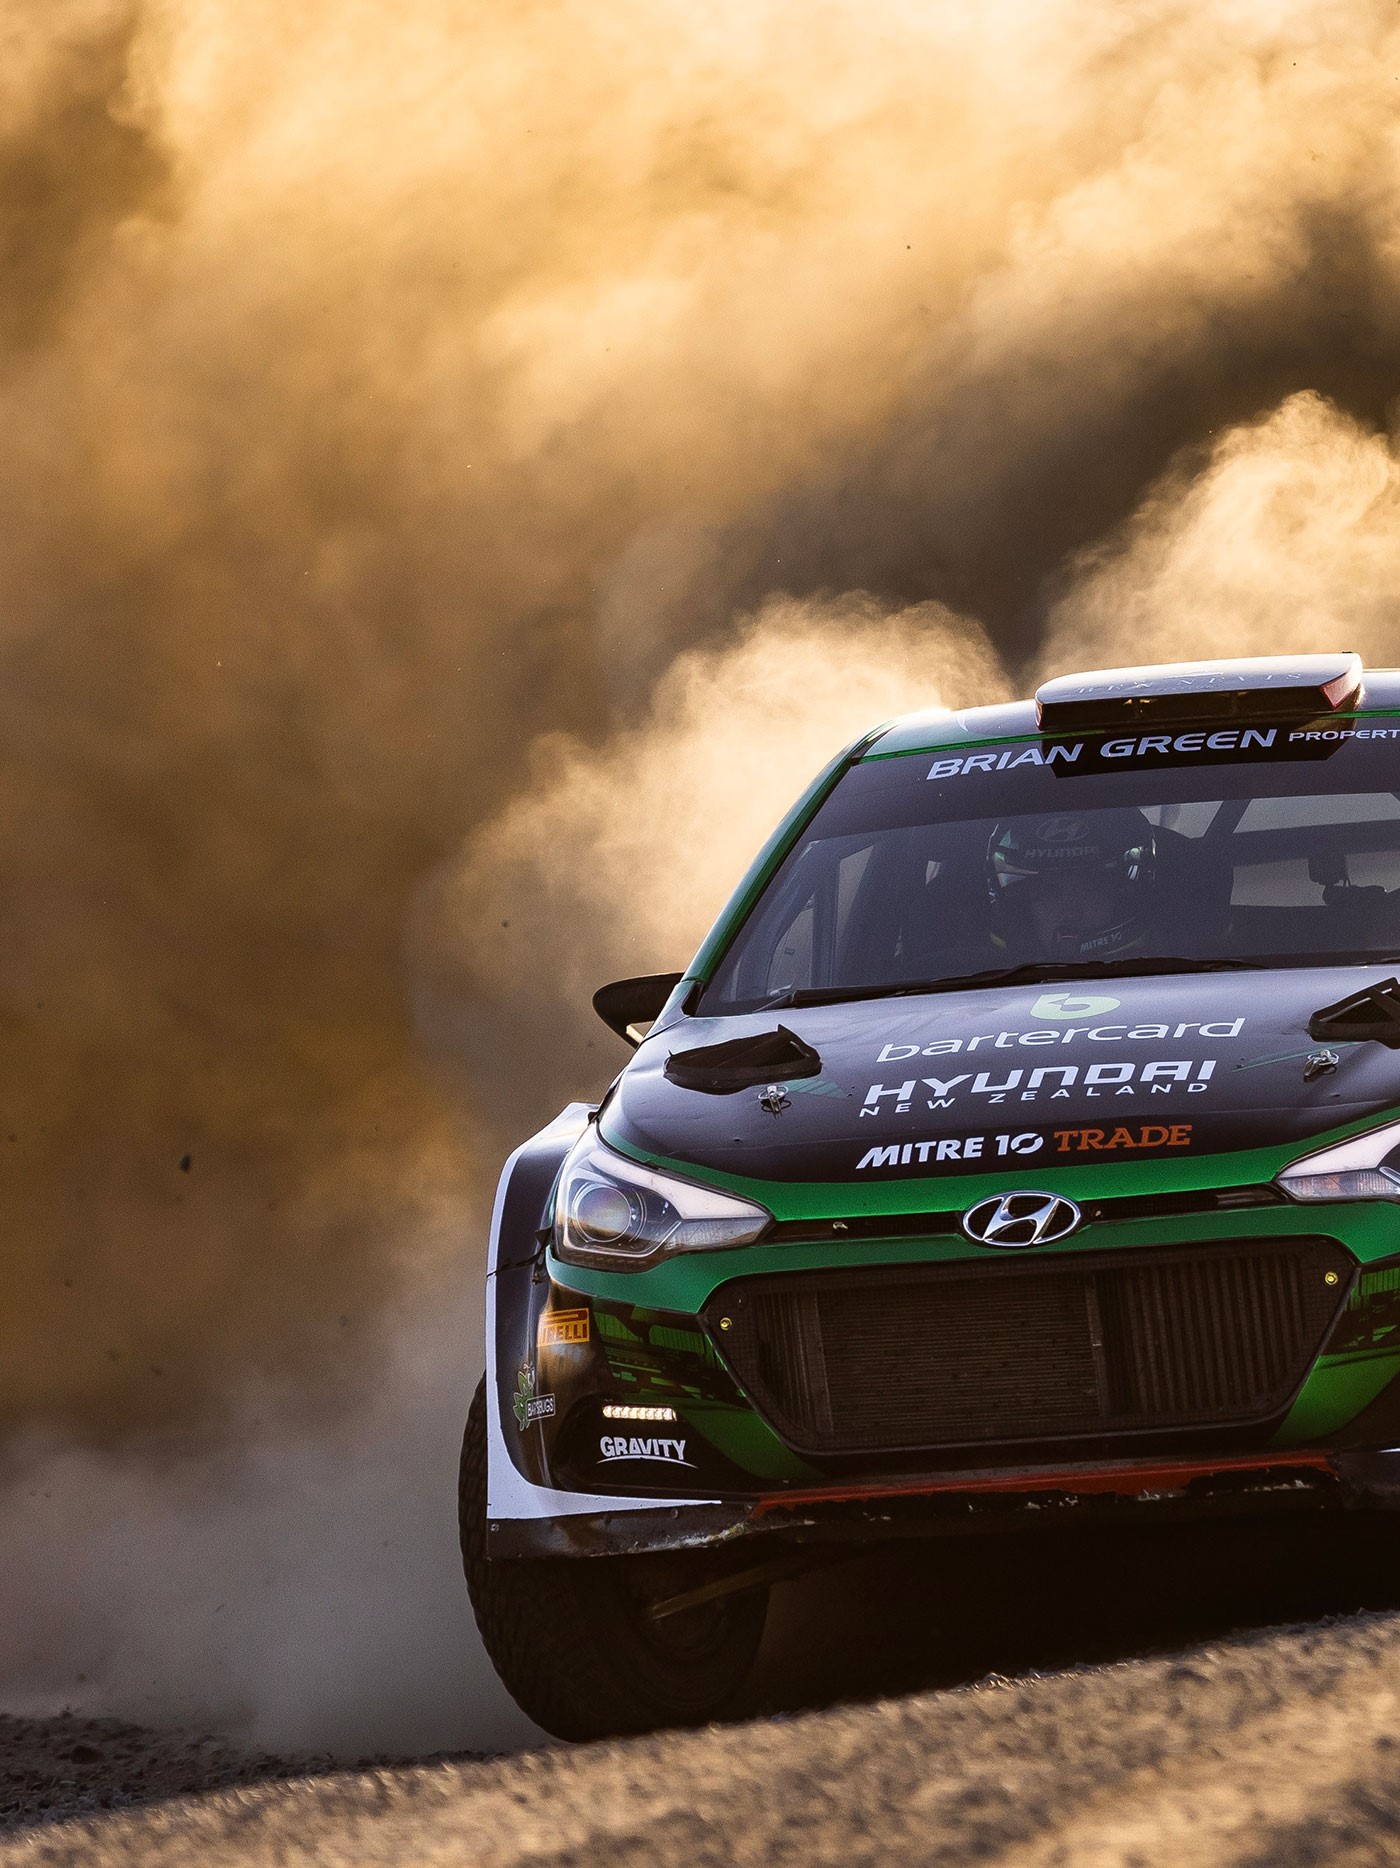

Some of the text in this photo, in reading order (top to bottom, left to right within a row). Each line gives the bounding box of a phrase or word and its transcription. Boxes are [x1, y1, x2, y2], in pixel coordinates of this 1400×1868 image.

[926, 743, 1083, 780] BRIAN
[1100, 729, 1277, 758] GREEN
[1079, 935, 1109, 954] MITRE
[876, 1018, 1245, 1063] bartercard
[859, 1082, 1208, 1118] NEW ZEALAND
[863, 1060, 1217, 1105] HYUNDAI
[856, 1124, 1193, 1170] MITRE 10 TRADE
[600, 1436, 686, 1461] GRAVITY
